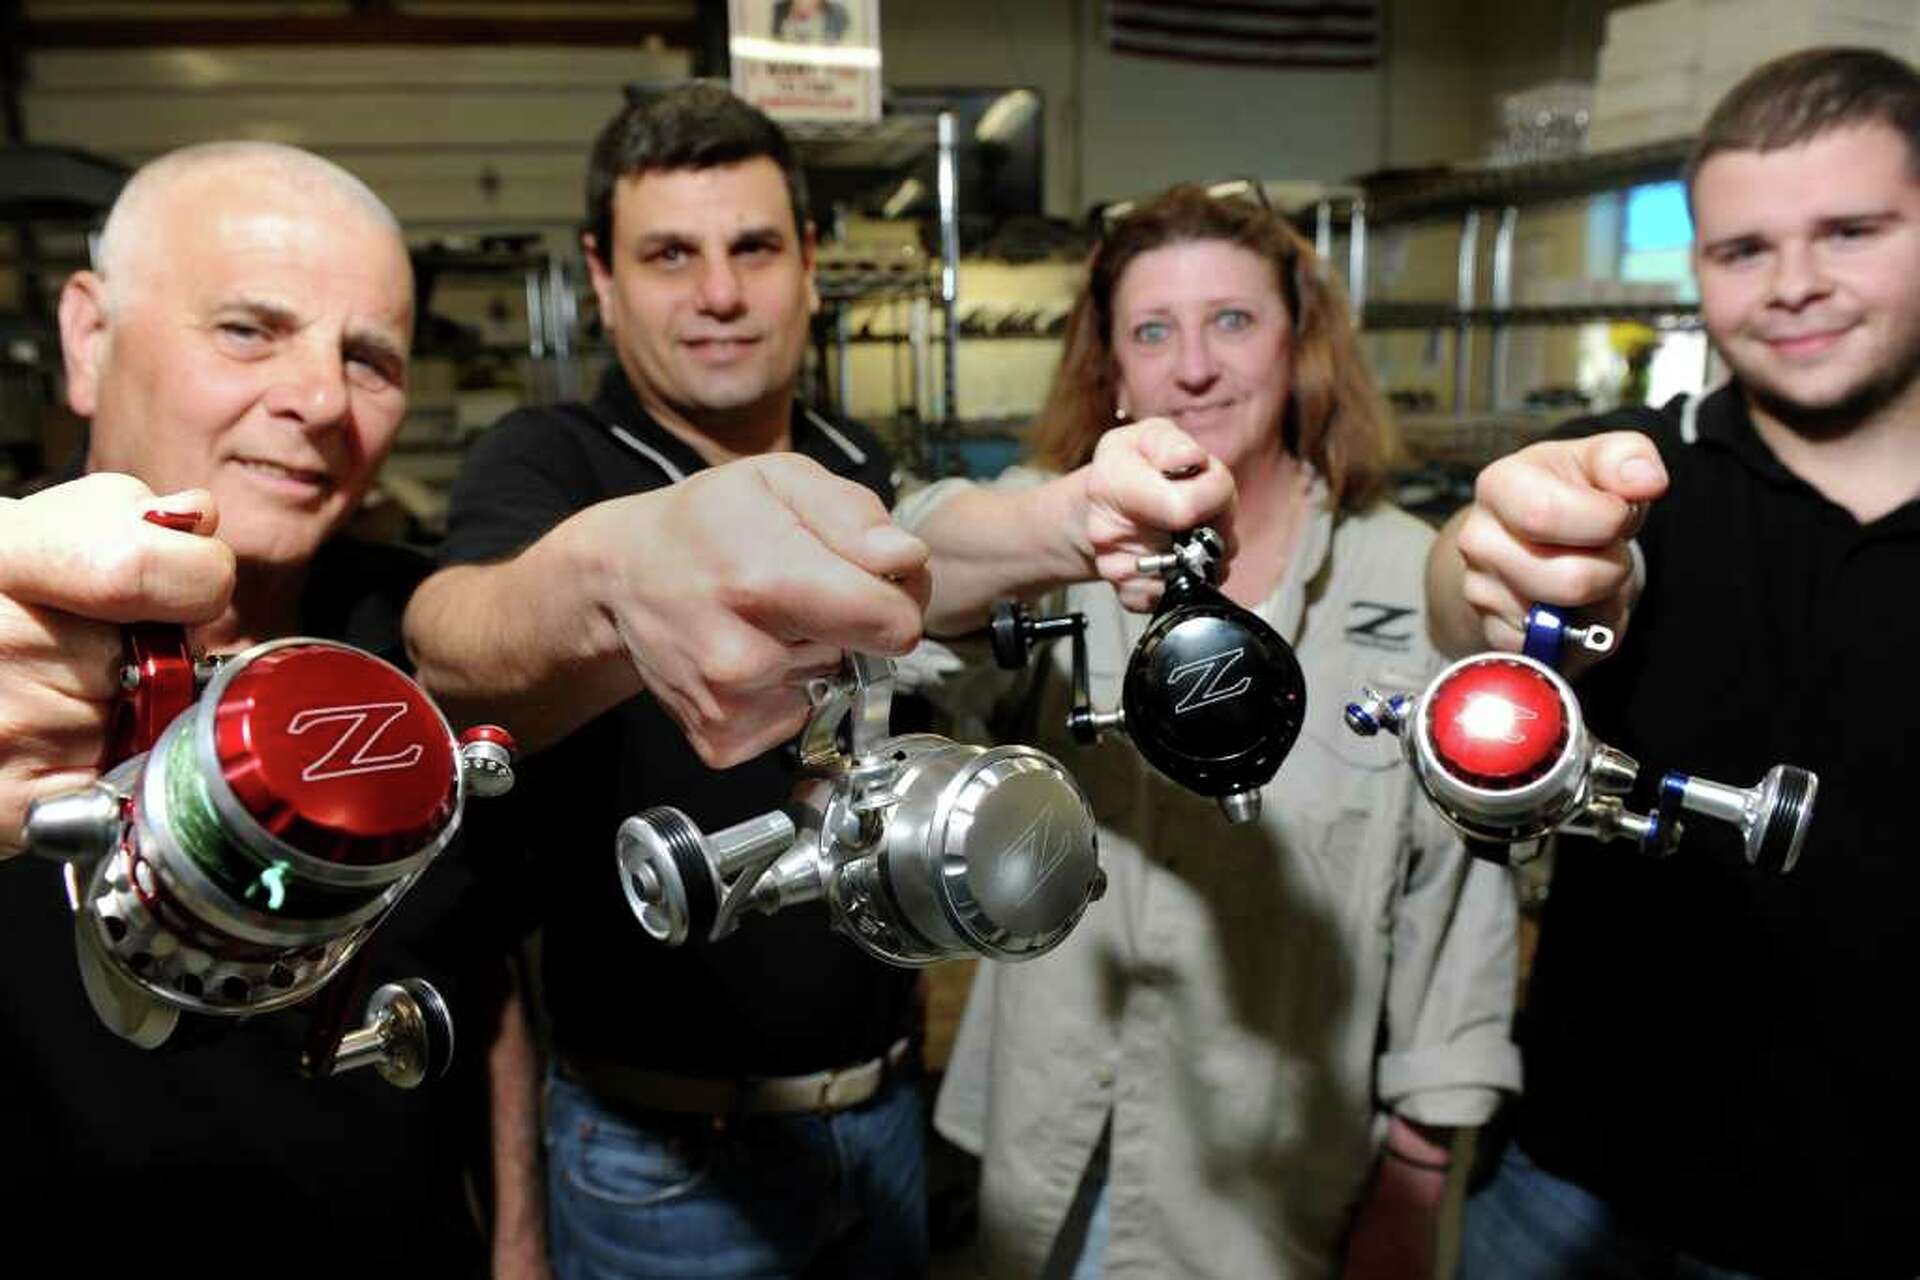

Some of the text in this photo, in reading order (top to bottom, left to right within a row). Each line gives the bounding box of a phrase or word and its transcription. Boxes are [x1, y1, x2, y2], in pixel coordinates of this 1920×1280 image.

[1346, 601, 1417, 641] Z
[1167, 648, 1251, 714] Z
[287, 702, 423, 781] Z
[998, 802, 1072, 908] Z
